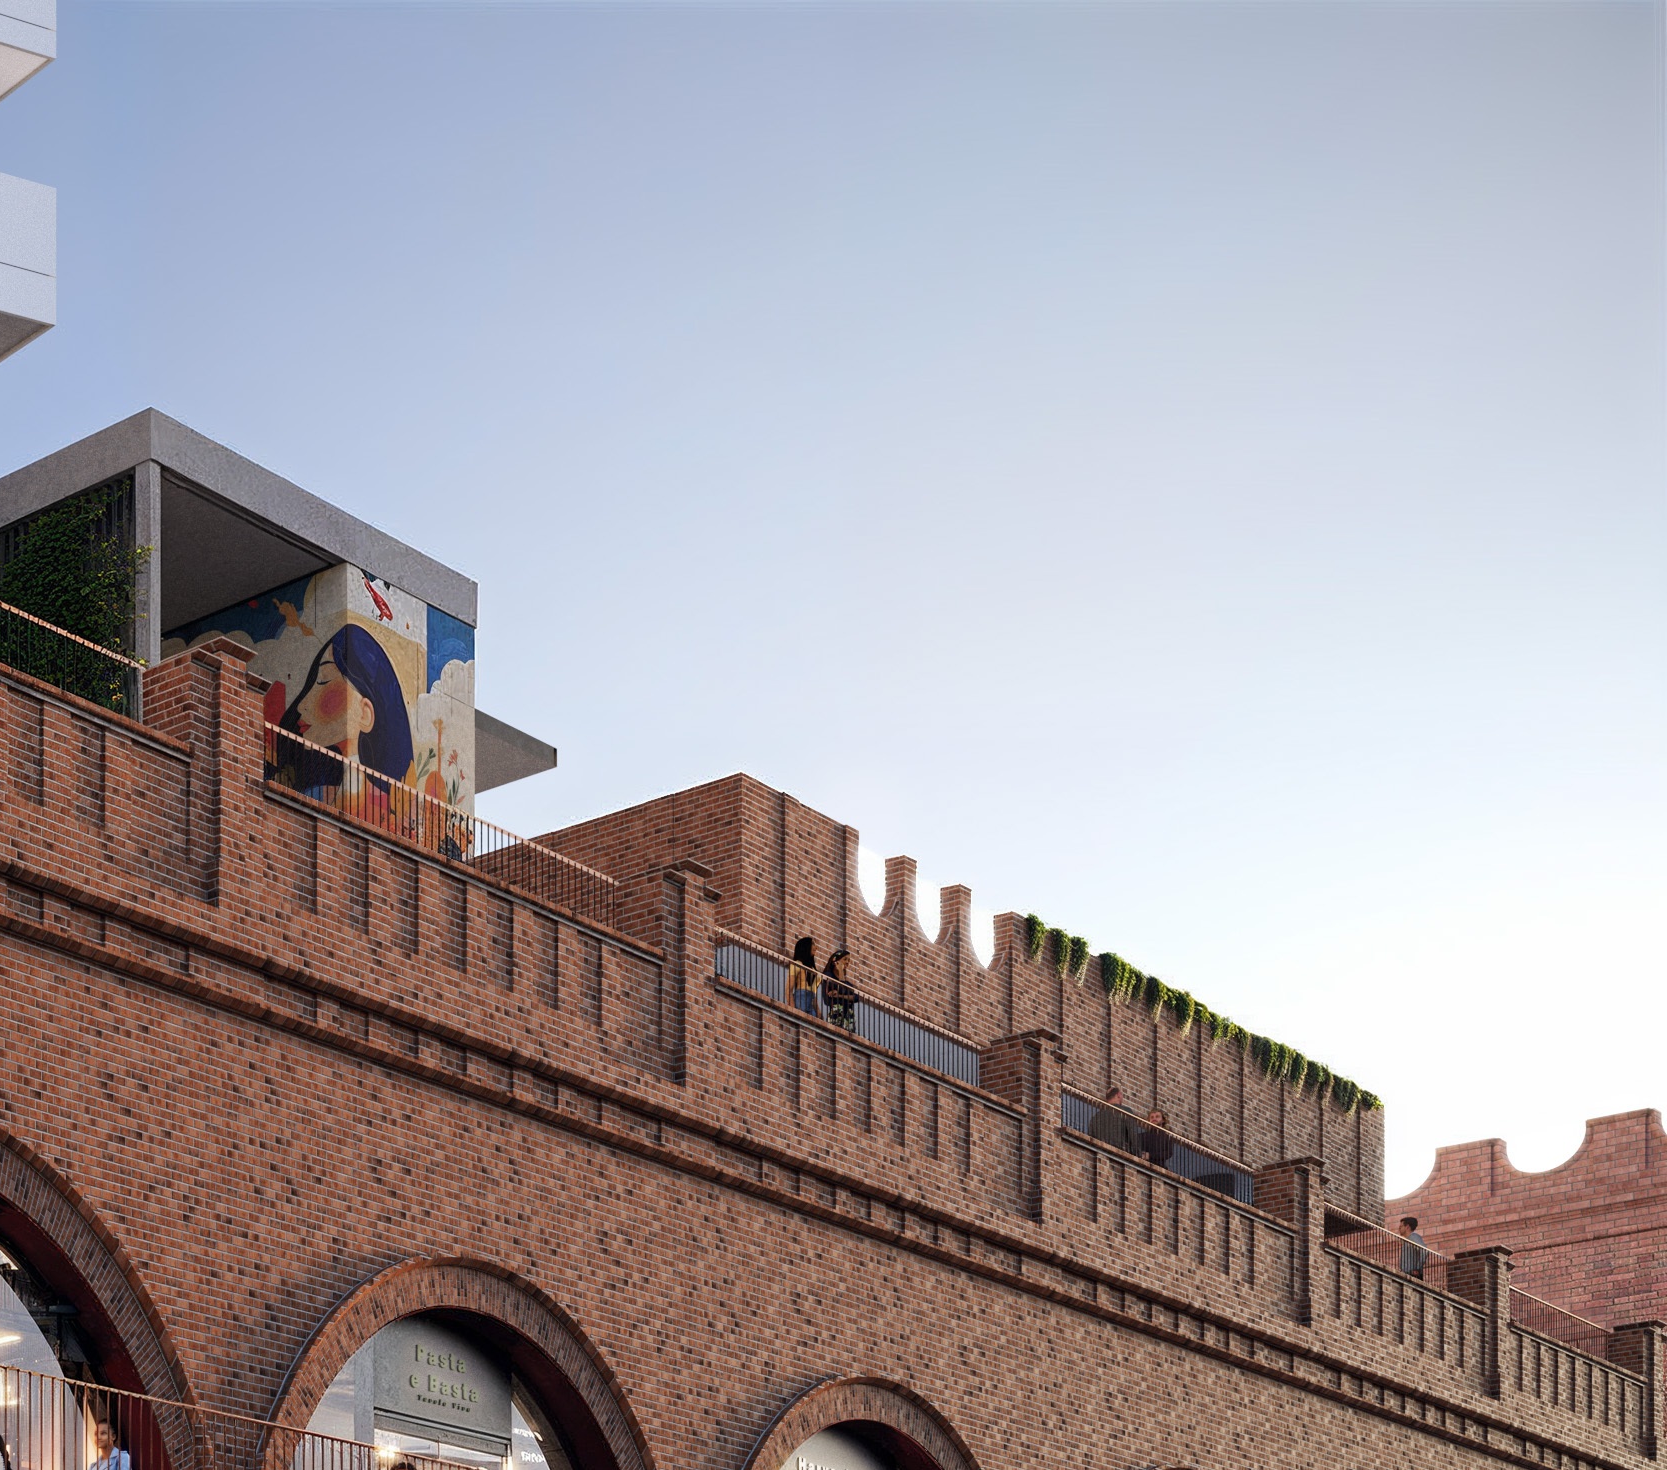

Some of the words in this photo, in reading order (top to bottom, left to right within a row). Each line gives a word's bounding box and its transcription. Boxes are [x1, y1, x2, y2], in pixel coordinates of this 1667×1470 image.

[415, 1344, 466, 1374] Pasta
[409, 1373, 419, 1389] e
[427, 1374, 479, 1403] Basta
